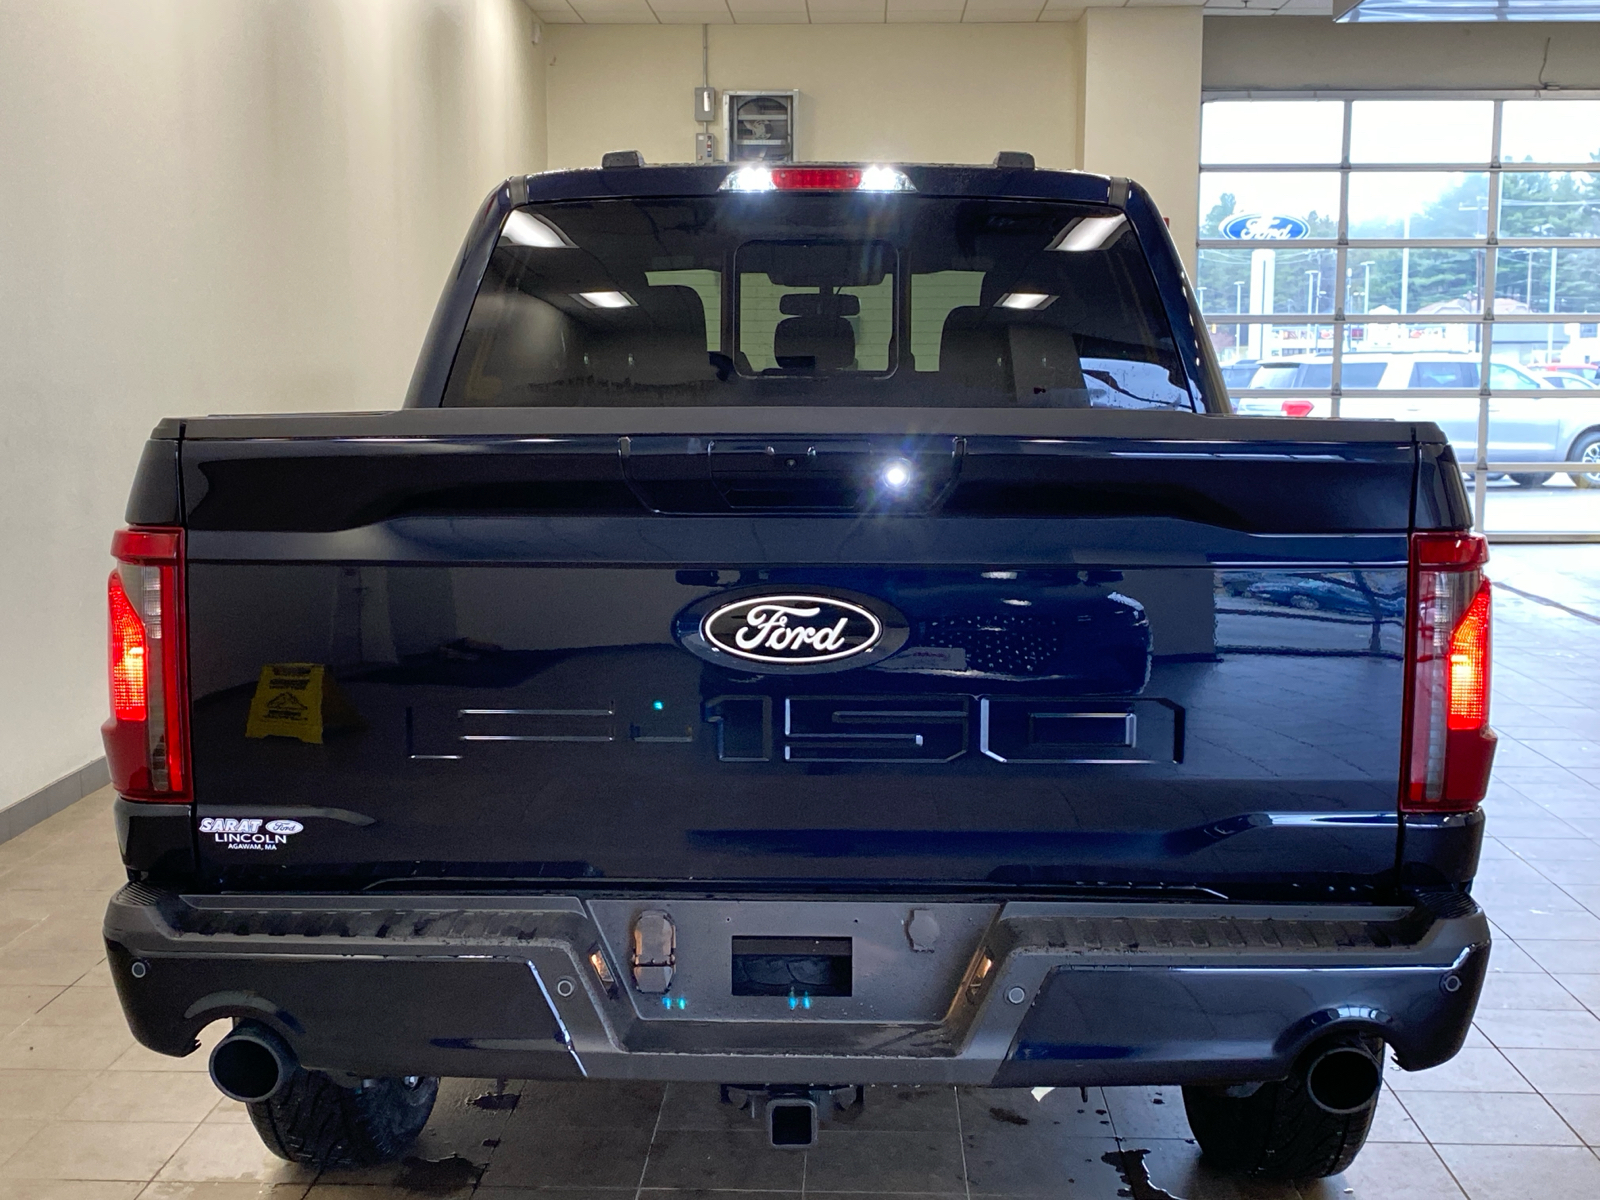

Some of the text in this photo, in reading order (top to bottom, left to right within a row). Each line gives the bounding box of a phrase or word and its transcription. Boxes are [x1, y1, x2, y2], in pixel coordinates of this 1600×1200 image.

[1241, 217, 1293, 240] Ford
[735, 604, 848, 650] Ford
[404, 694, 1186, 765] F-150
[199, 817, 264, 833] SARAT
[215, 833, 287, 844] LINCOLN
[227, 843, 264, 851] AGAWAM,
